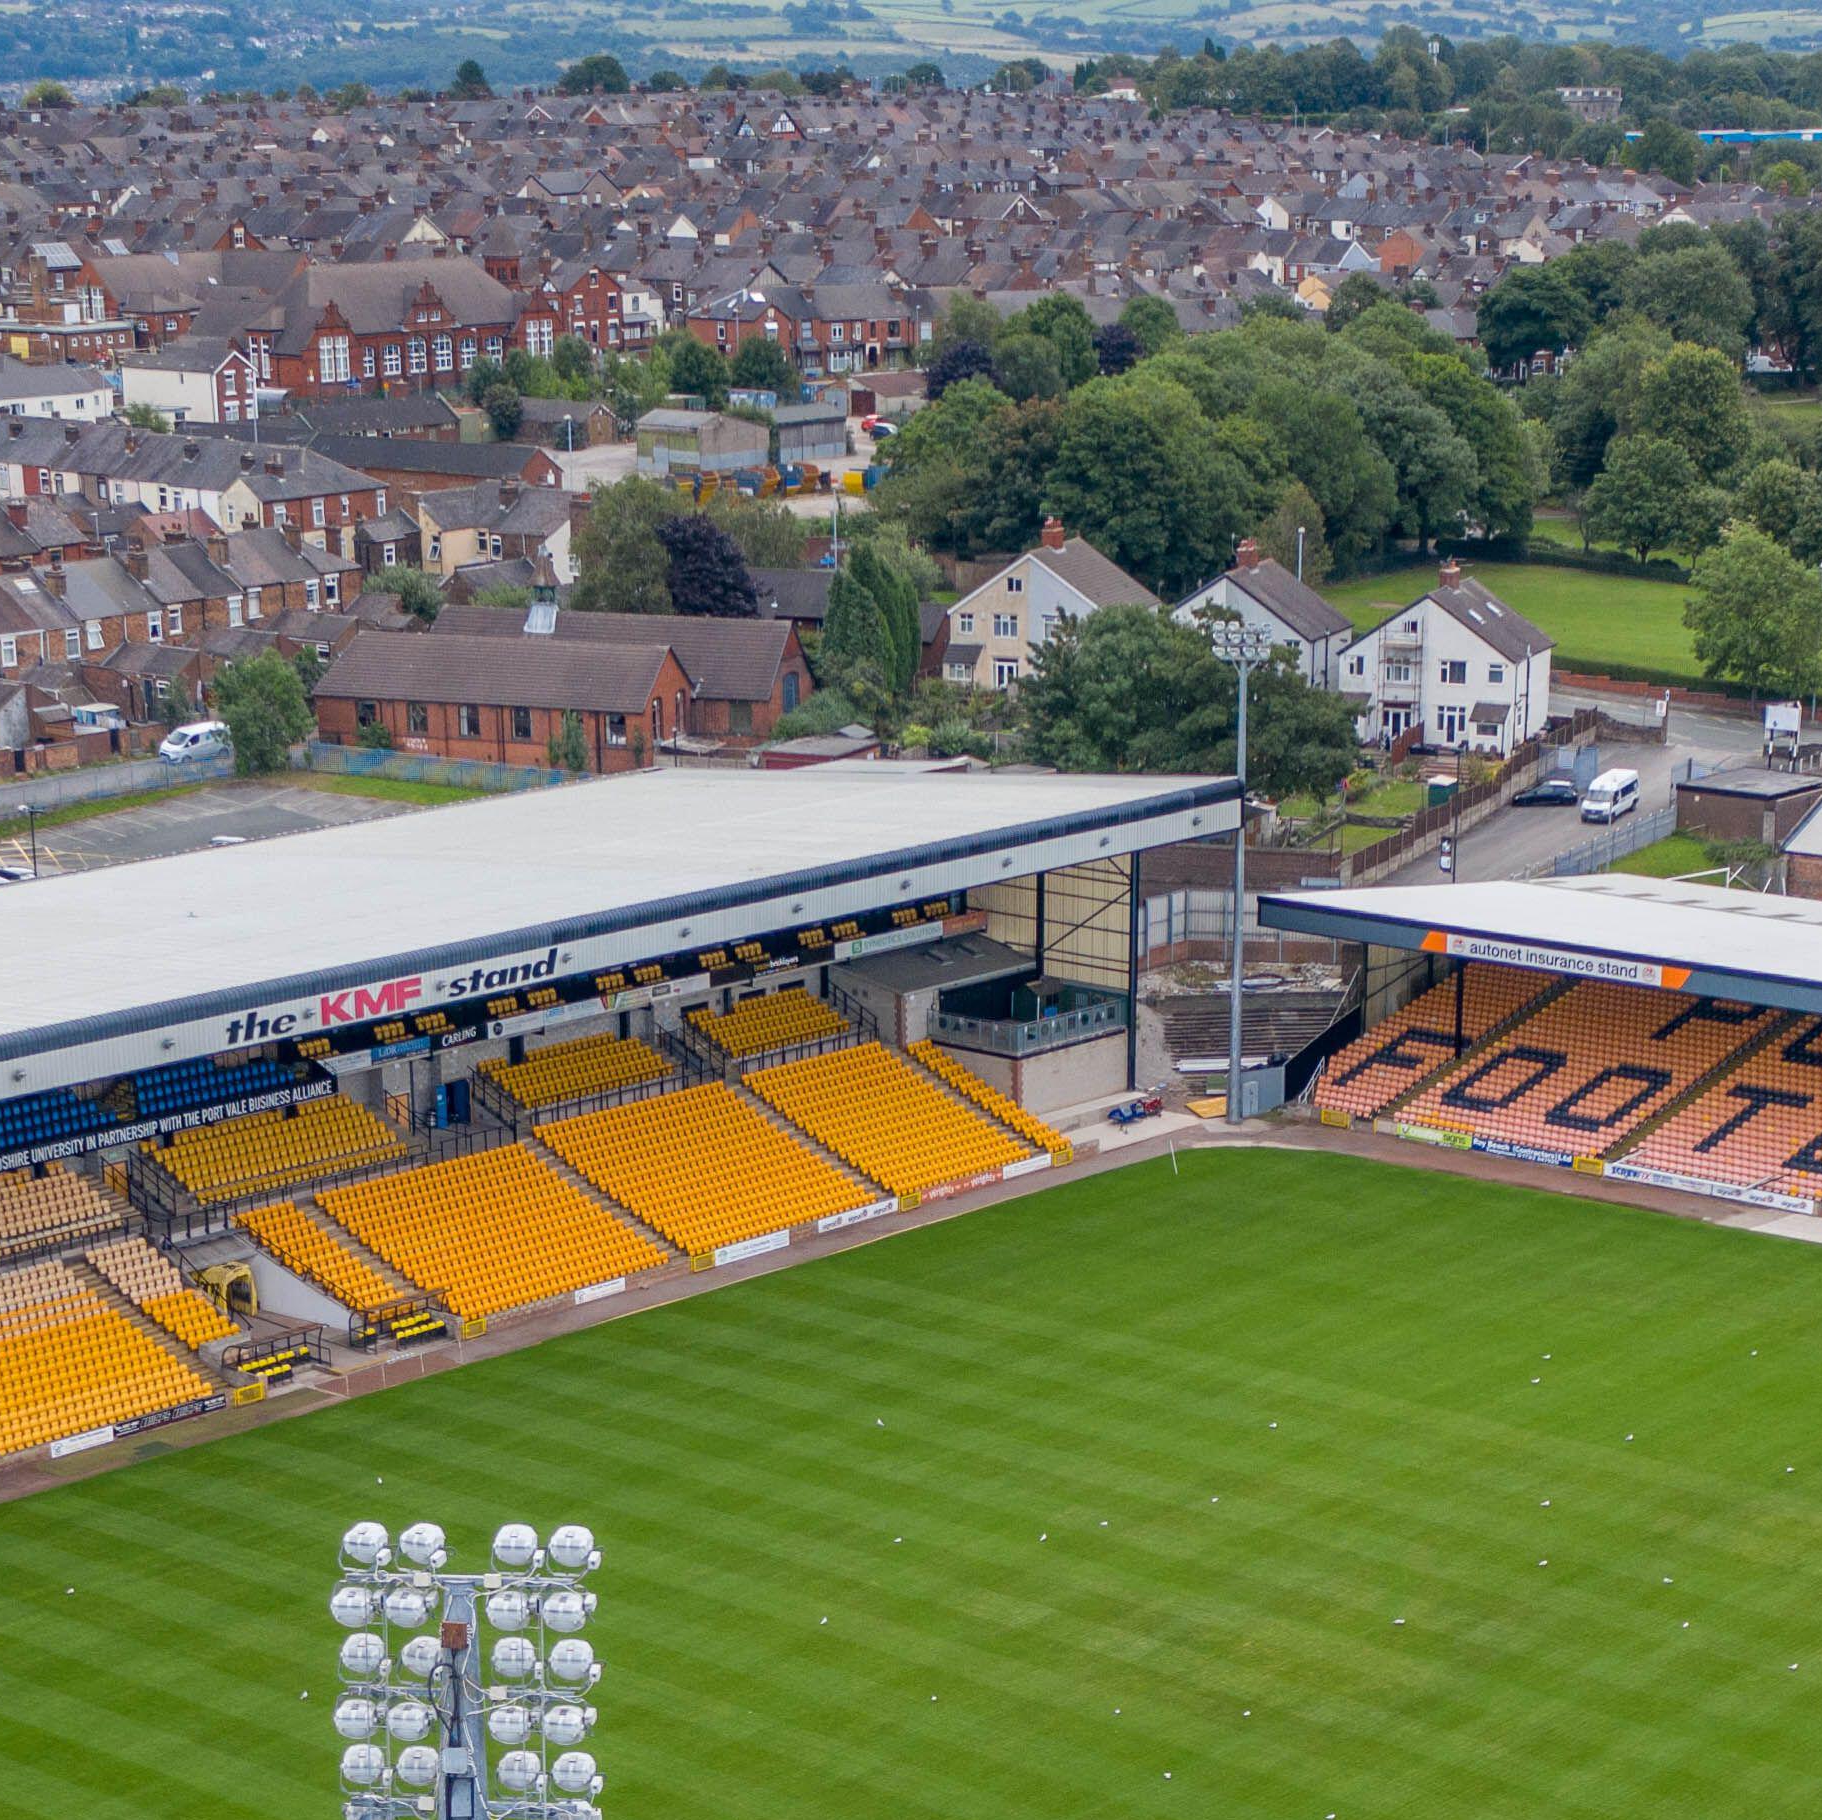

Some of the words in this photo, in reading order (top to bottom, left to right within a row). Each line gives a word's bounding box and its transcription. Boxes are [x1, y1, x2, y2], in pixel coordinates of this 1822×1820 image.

[1470, 942, 1522, 960] autonet
[1526, 949, 1594, 973] insurance
[1598, 962, 1637, 979] stand
[226, 1012, 297, 1045] the
[319, 976, 423, 1026] KMF
[448, 948, 557, 998] stand
[442, 1026, 477, 1047] CARLING
[31, 1138, 84, 1163] UNIVERSITY
[86, 1134, 97, 1150] IN
[98, 1122, 158, 1148] PARTNERSHIP
[159, 1117, 182, 1133] WITH
[183, 1110, 201, 1128] THE
[202, 1106, 225, 1124] PORT
[226, 1098, 248, 1115] VALE
[248, 1090, 291, 1113] BUSINESS
[292, 1080, 332, 1102] ALLIANCE
